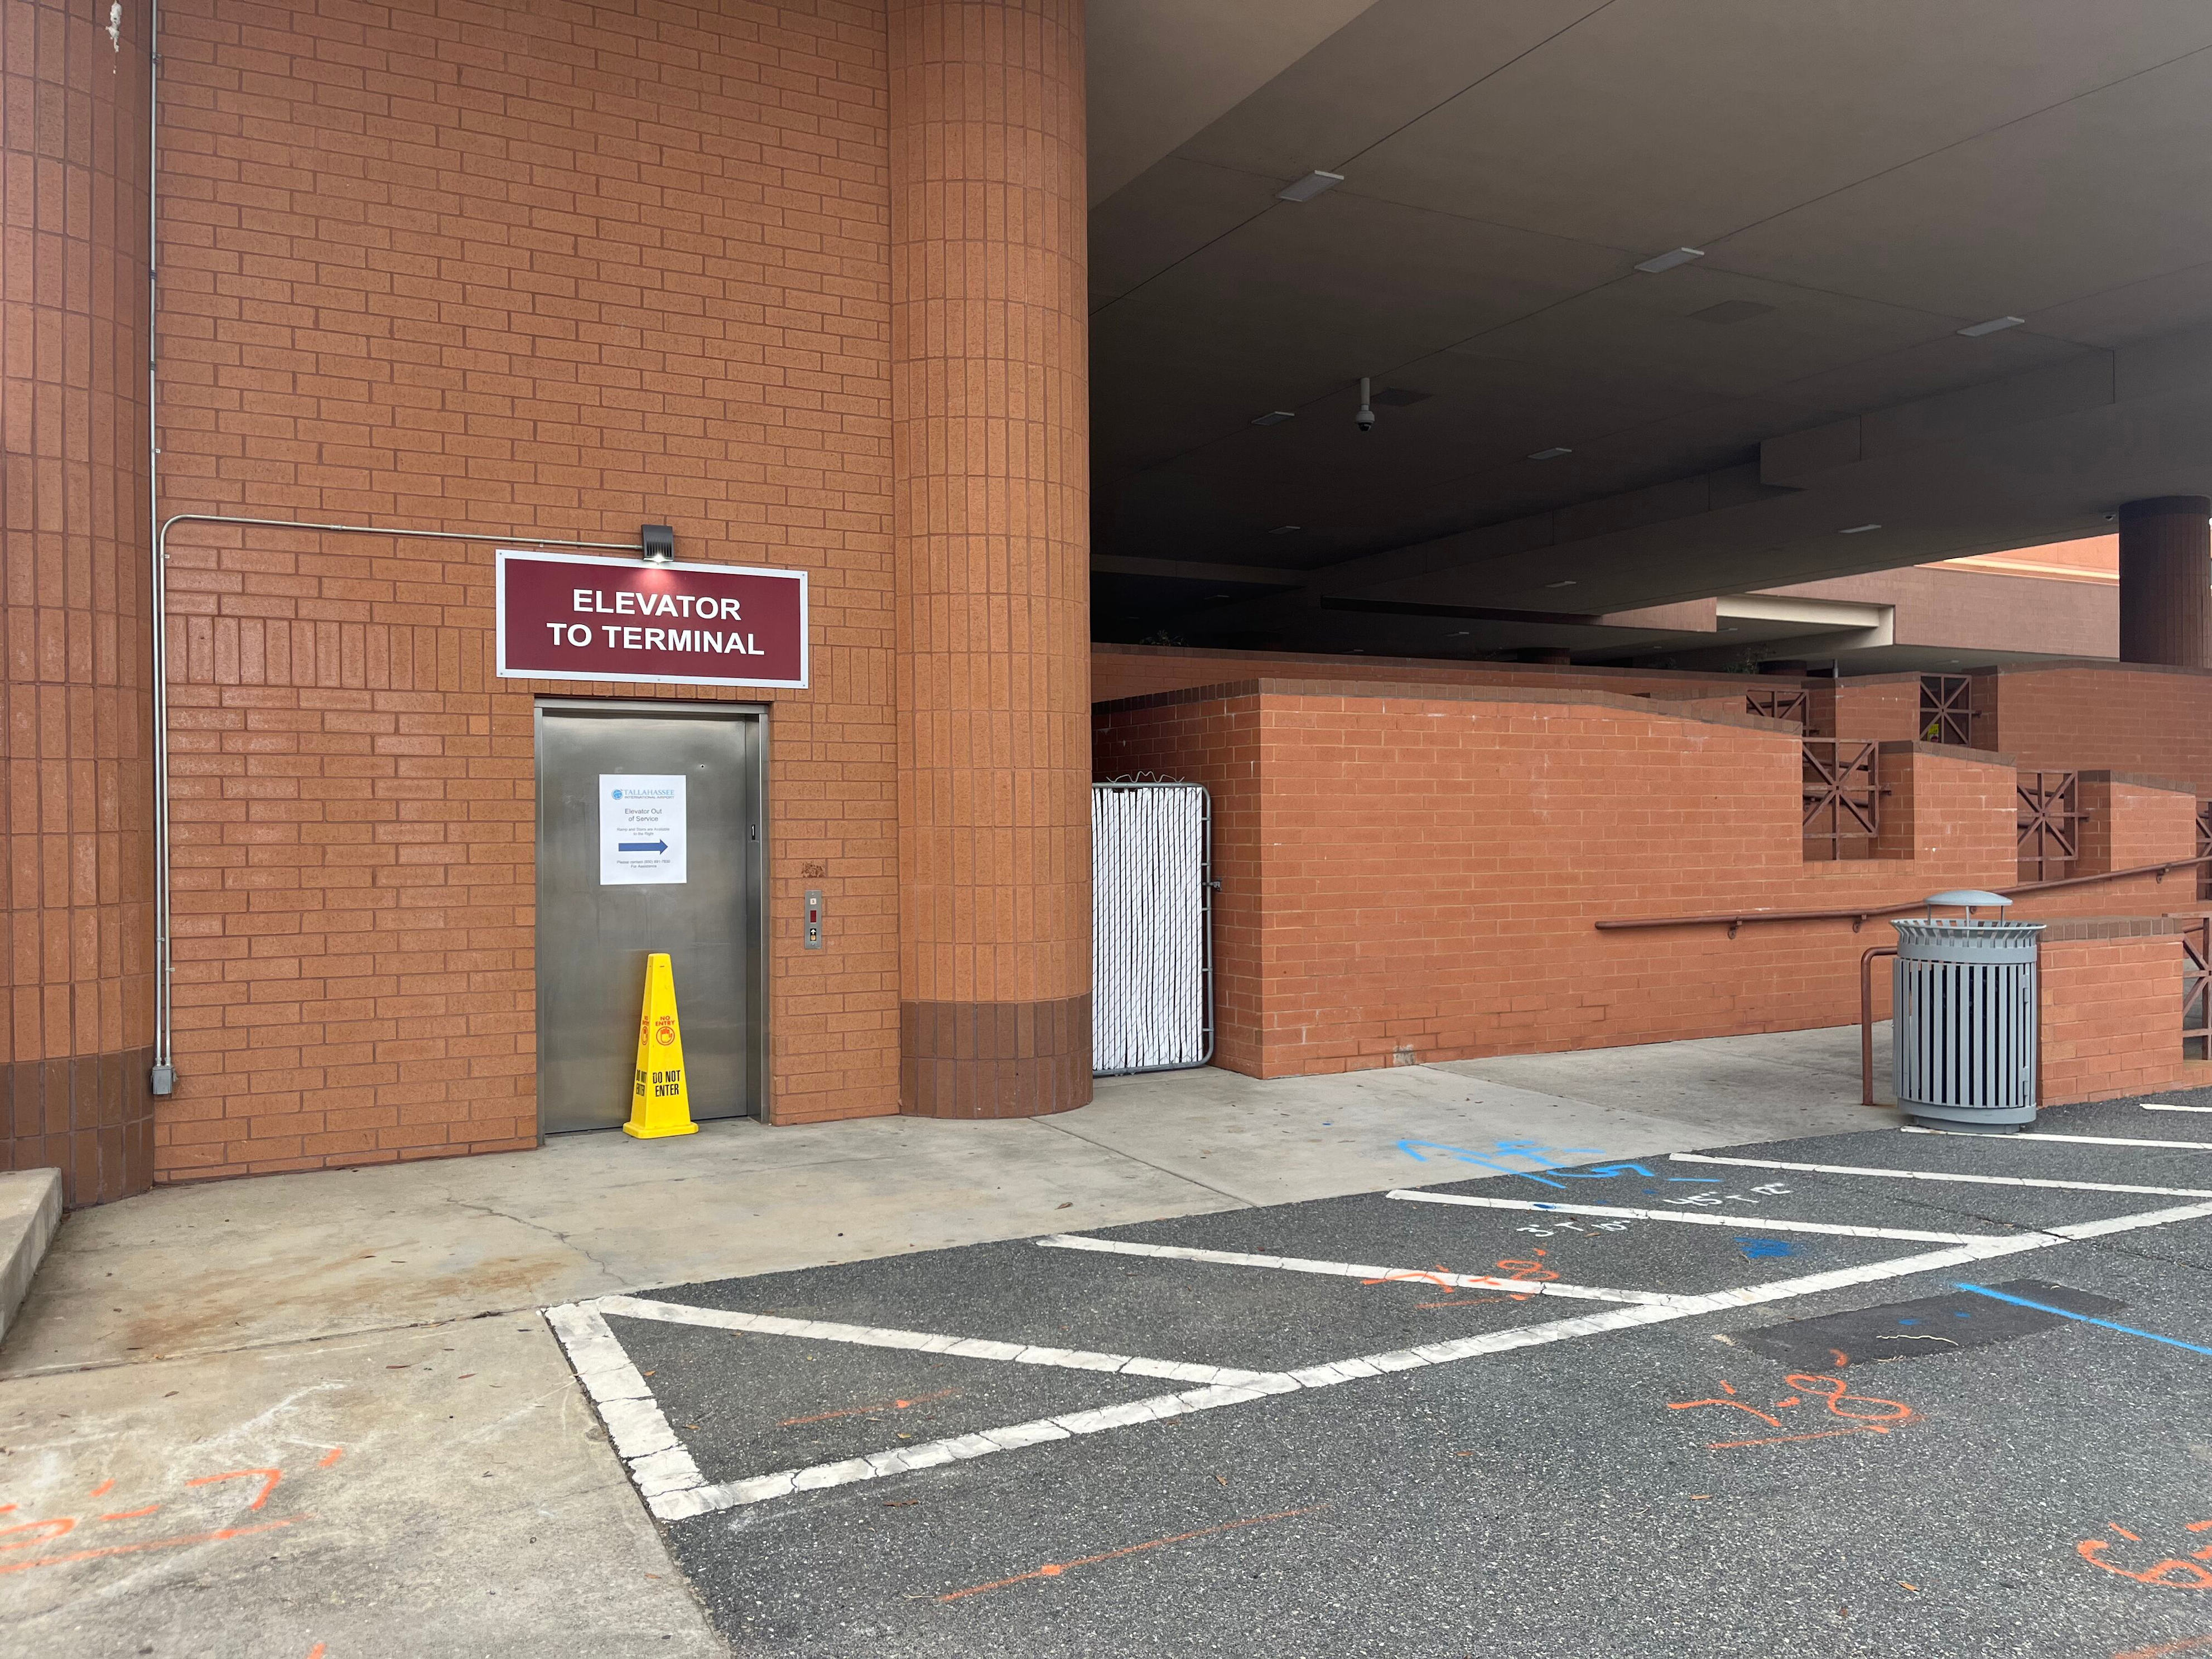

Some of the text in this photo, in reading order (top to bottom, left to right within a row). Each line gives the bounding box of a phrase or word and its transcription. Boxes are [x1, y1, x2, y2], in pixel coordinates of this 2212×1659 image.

[573, 589, 742, 621] ELEVATOR
[546, 622, 765, 656] TO TERMINAL
[653, 1070, 681, 1084] DO NOT
[655, 1083, 679, 1097] ENTER
